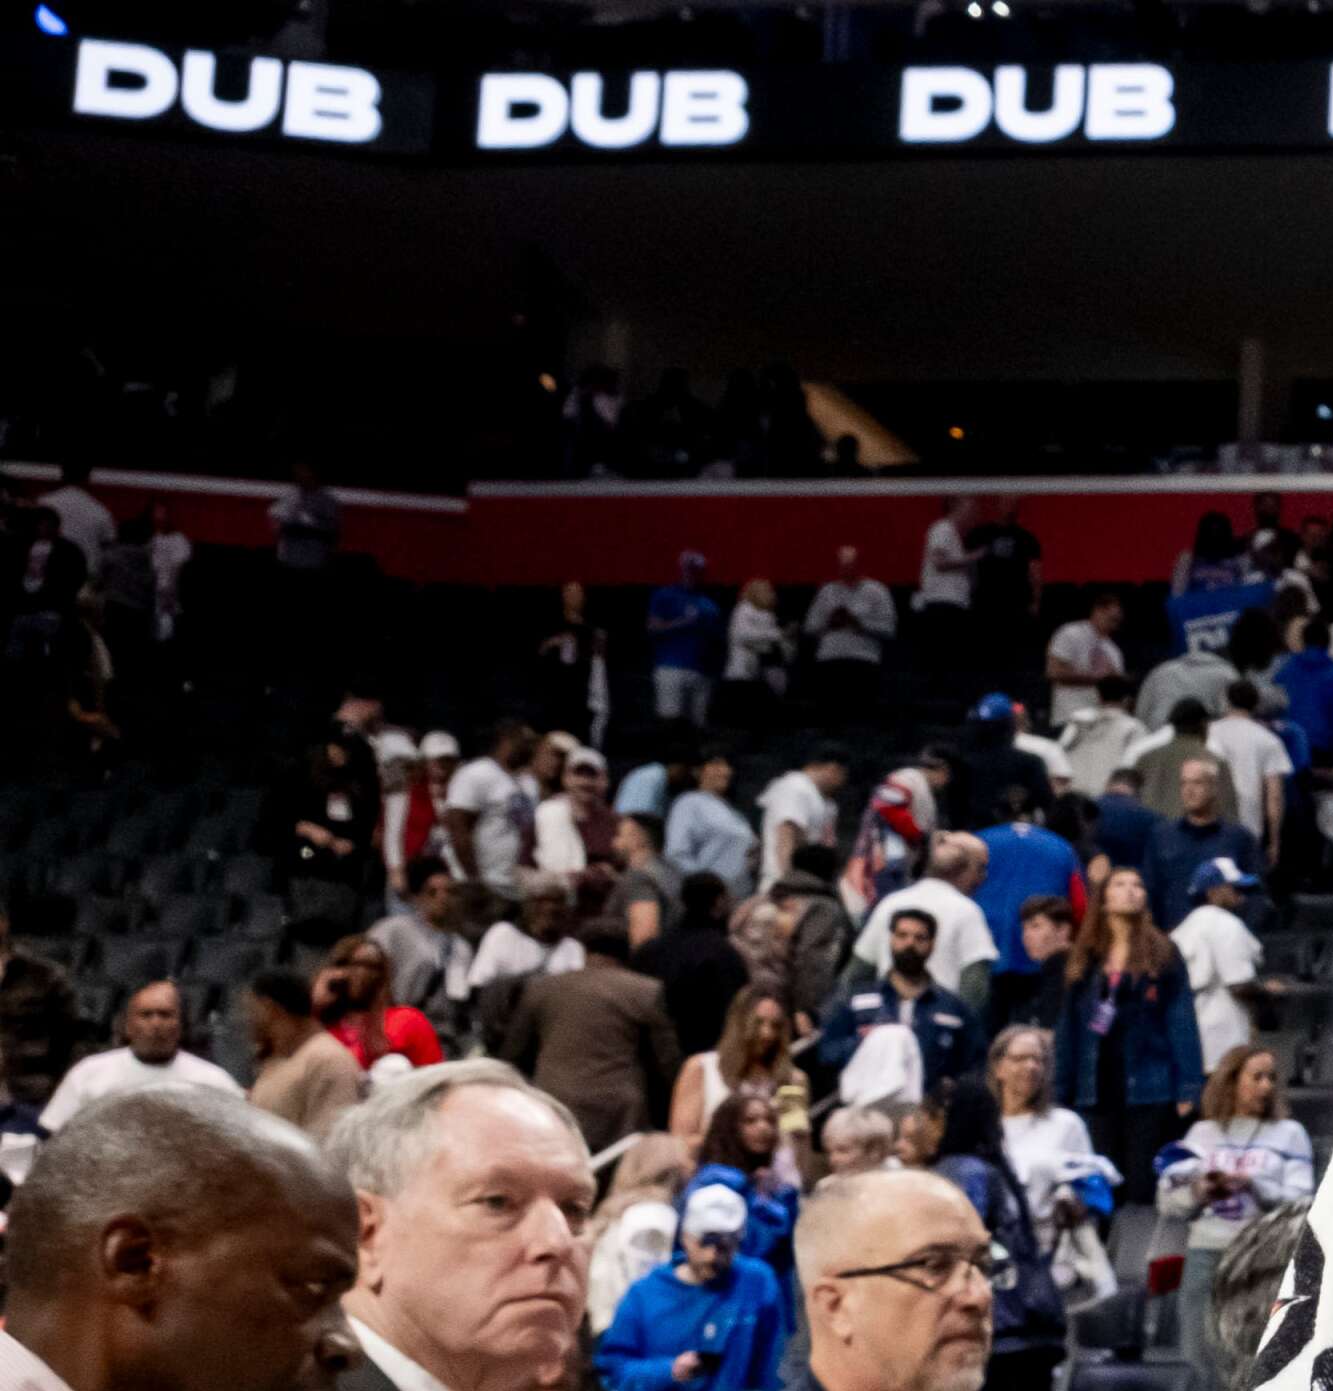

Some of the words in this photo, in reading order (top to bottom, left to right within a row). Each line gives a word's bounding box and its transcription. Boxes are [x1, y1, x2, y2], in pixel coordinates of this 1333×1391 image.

[74, 39, 382, 142] DUB
[477, 70, 749, 149] DUB
[899, 64, 1176, 142] DUB
